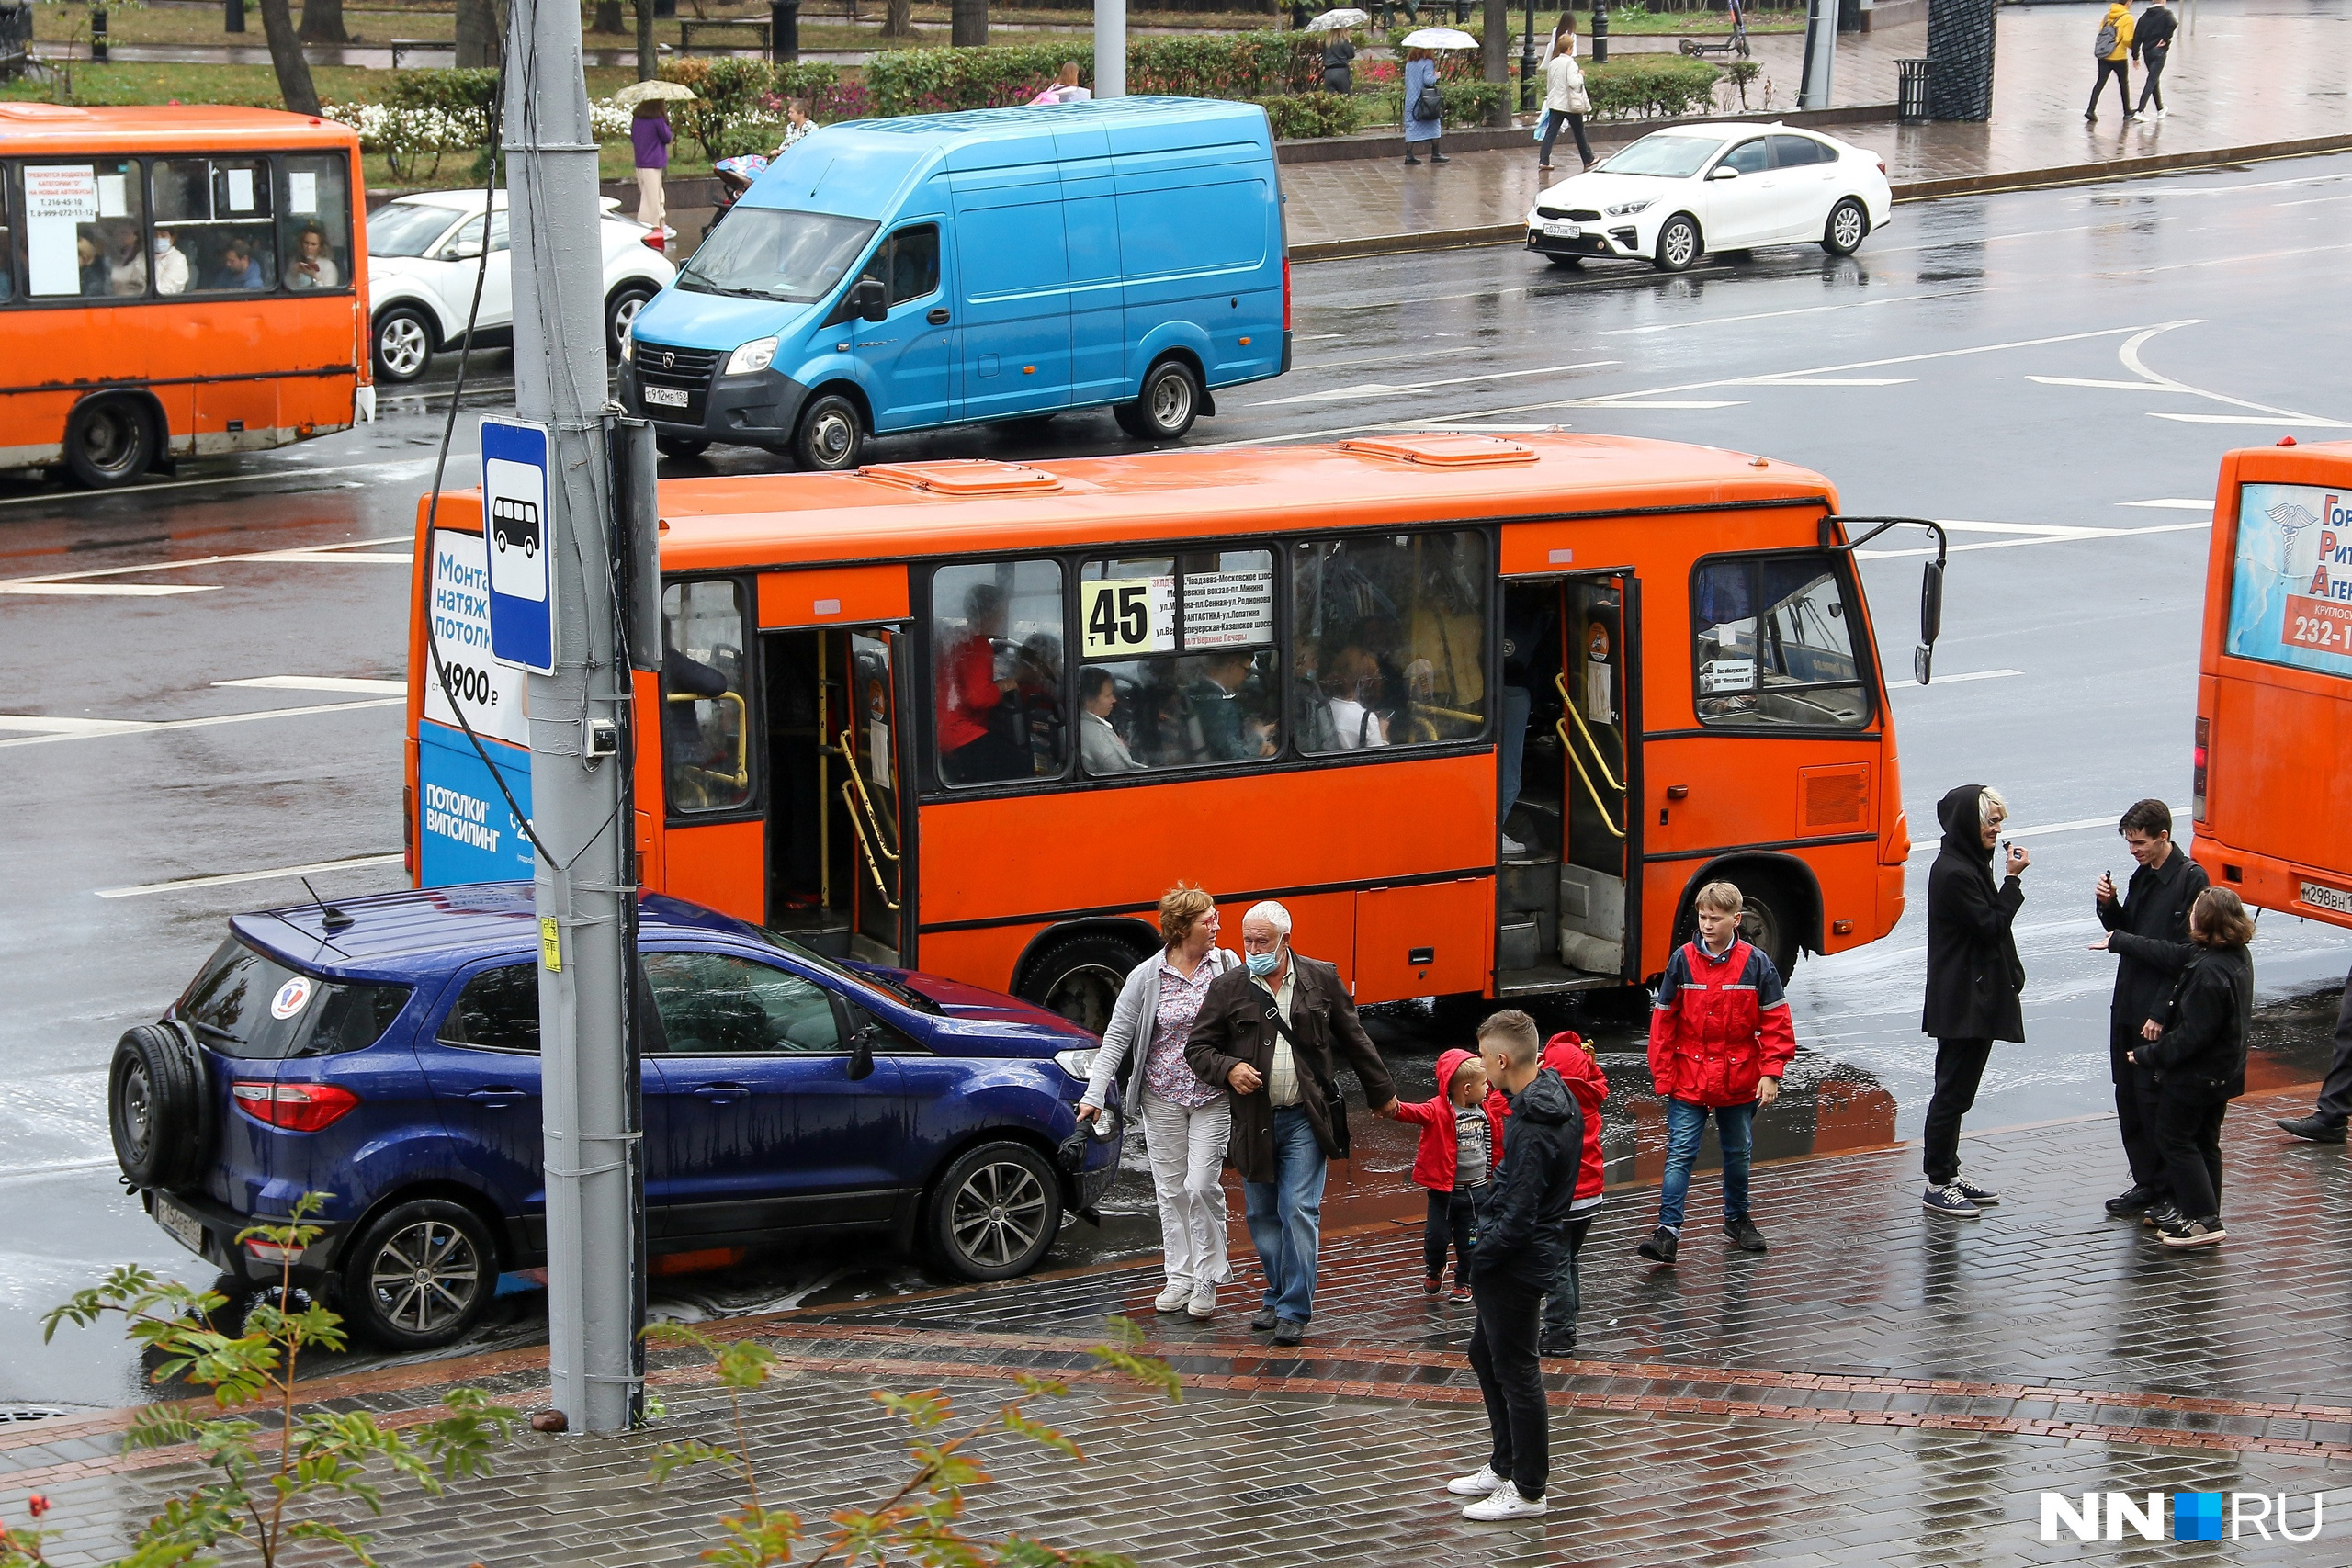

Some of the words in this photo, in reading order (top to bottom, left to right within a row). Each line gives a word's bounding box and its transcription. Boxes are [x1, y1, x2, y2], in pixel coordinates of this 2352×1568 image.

[437, 551, 488, 592] Монта
[436, 587, 489, 621] натяж
[1089, 586, 1148, 645] 45
[425, 808, 501, 852] ВИПСИЛИНГ
